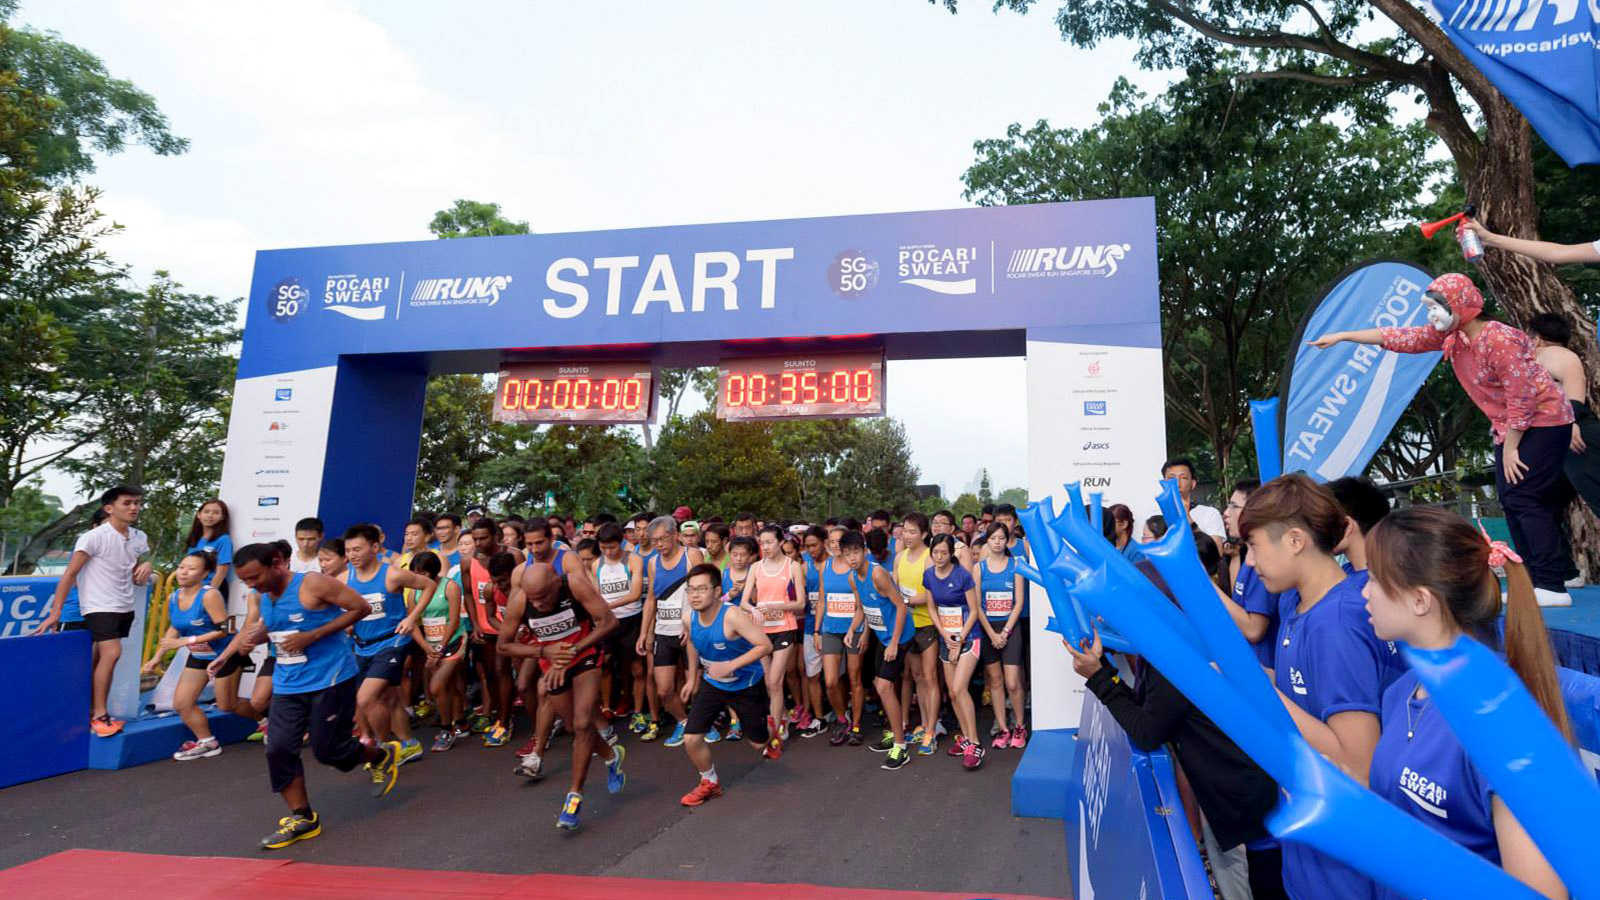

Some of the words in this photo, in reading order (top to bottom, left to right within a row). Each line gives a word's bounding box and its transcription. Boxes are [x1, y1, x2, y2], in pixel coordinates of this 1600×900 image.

[1476, 31, 1600, 57] w.pocarisw
[899, 247, 977, 264] POCARI
[840, 256, 867, 274] SG
[898, 260, 971, 276] SWEAT
[326, 277, 390, 291] POCARI
[543, 247, 795, 319] START
[840, 273, 867, 292] 50
[278, 285, 300, 300] SG
[324, 289, 383, 304] SWEAT
[275, 300, 299, 317] 50
[784, 360, 816, 368] SUUNTO
[502, 379, 641, 410] 00:00:00
[727, 370, 872, 406] 00:35:00
[1083, 477, 1111, 487] RUN
[602, 581, 627, 593] 30137
[987, 600, 1012, 609] 20542
[535, 619, 574, 636] 30537
[941, 616, 960, 626] 254
[1399, 775, 1442, 805] SWEAT
[1402, 767, 1447, 800] POCARI
